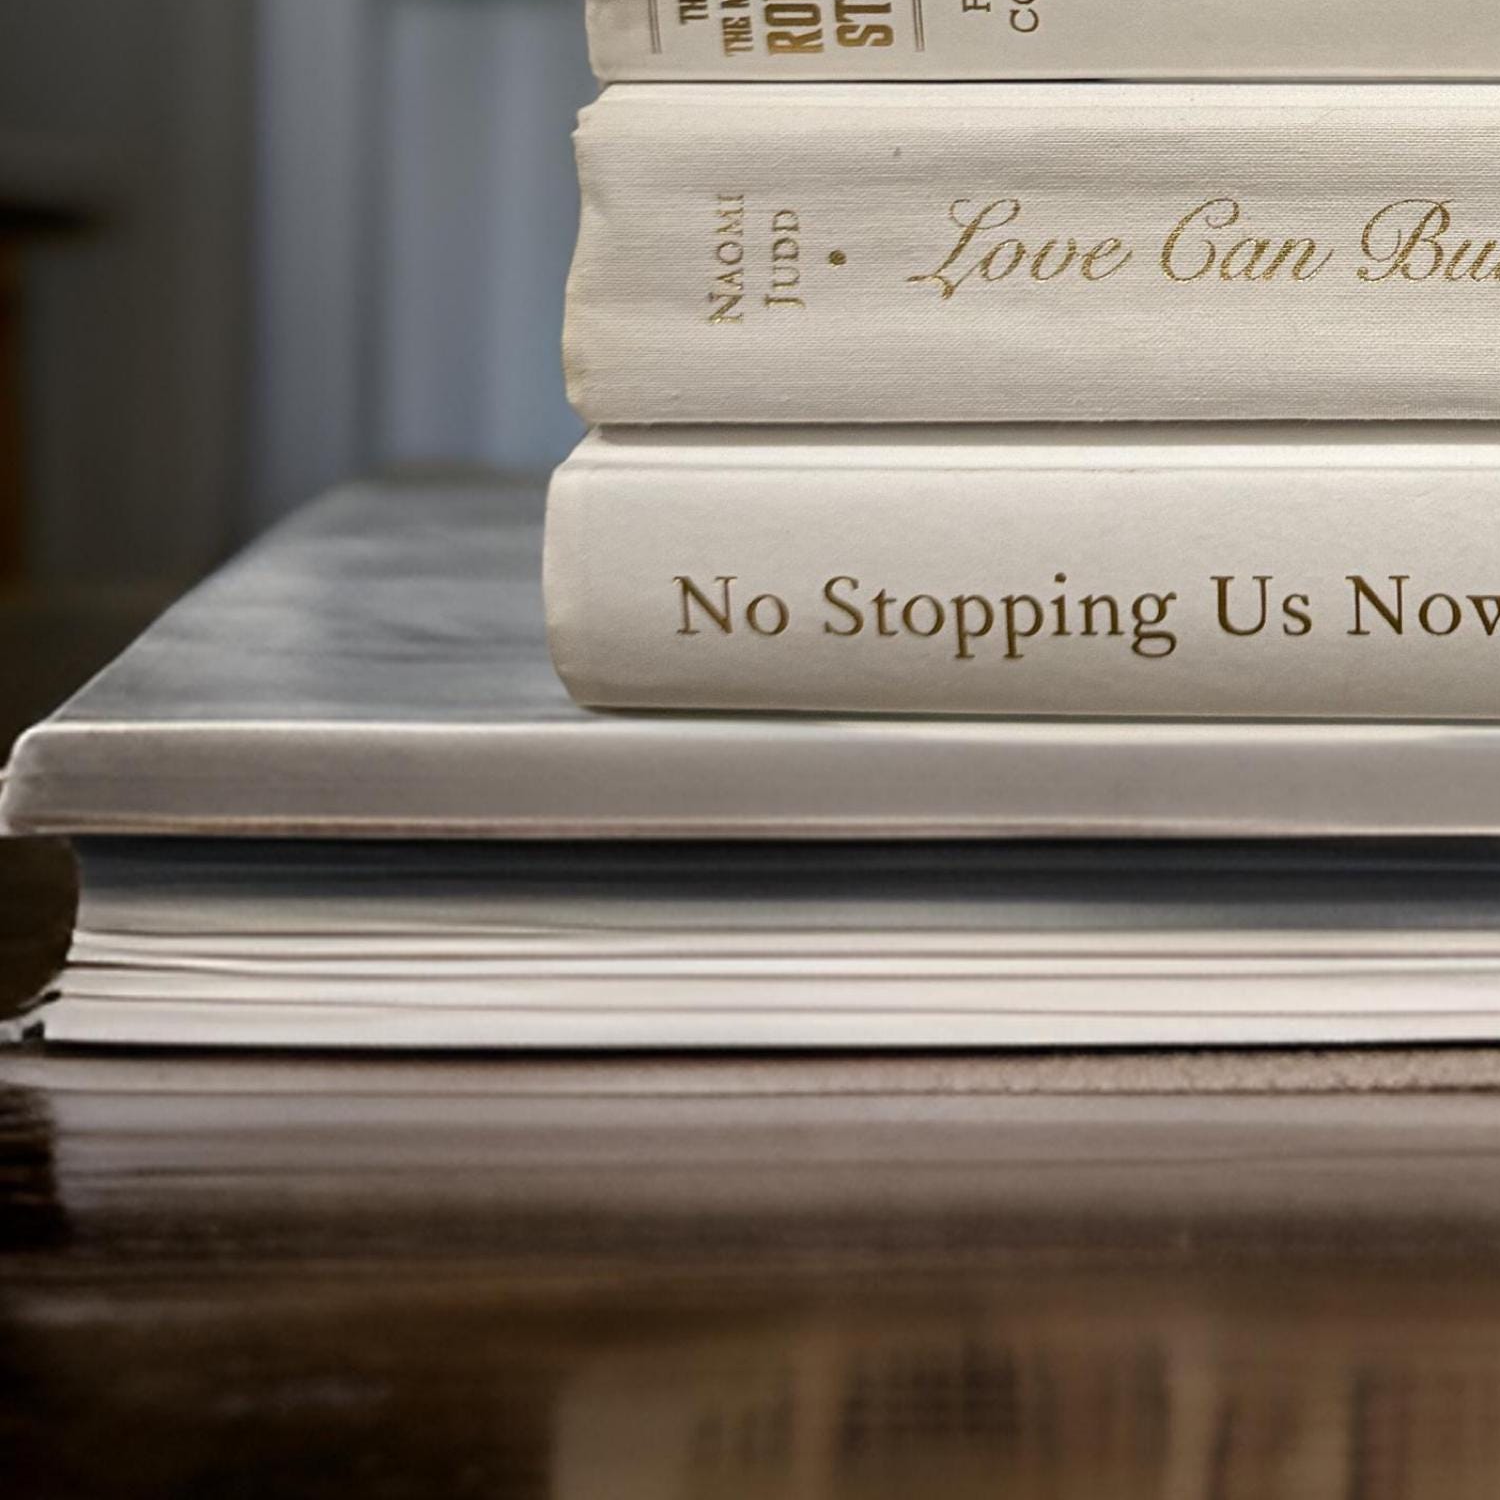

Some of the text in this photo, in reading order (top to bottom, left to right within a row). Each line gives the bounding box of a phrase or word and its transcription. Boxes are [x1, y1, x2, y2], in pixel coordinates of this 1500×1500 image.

[721, 16, 755, 58] THE
[707, 194, 745, 325] NAOMI
[763, 209, 806, 309] JUDD
[906, 198, 1133, 300] Love
[1158, 198, 1333, 283] Can
[673, 575, 790, 637] No
[822, 572, 1178, 659] Stopping
[1211, 575, 1313, 637] Us
